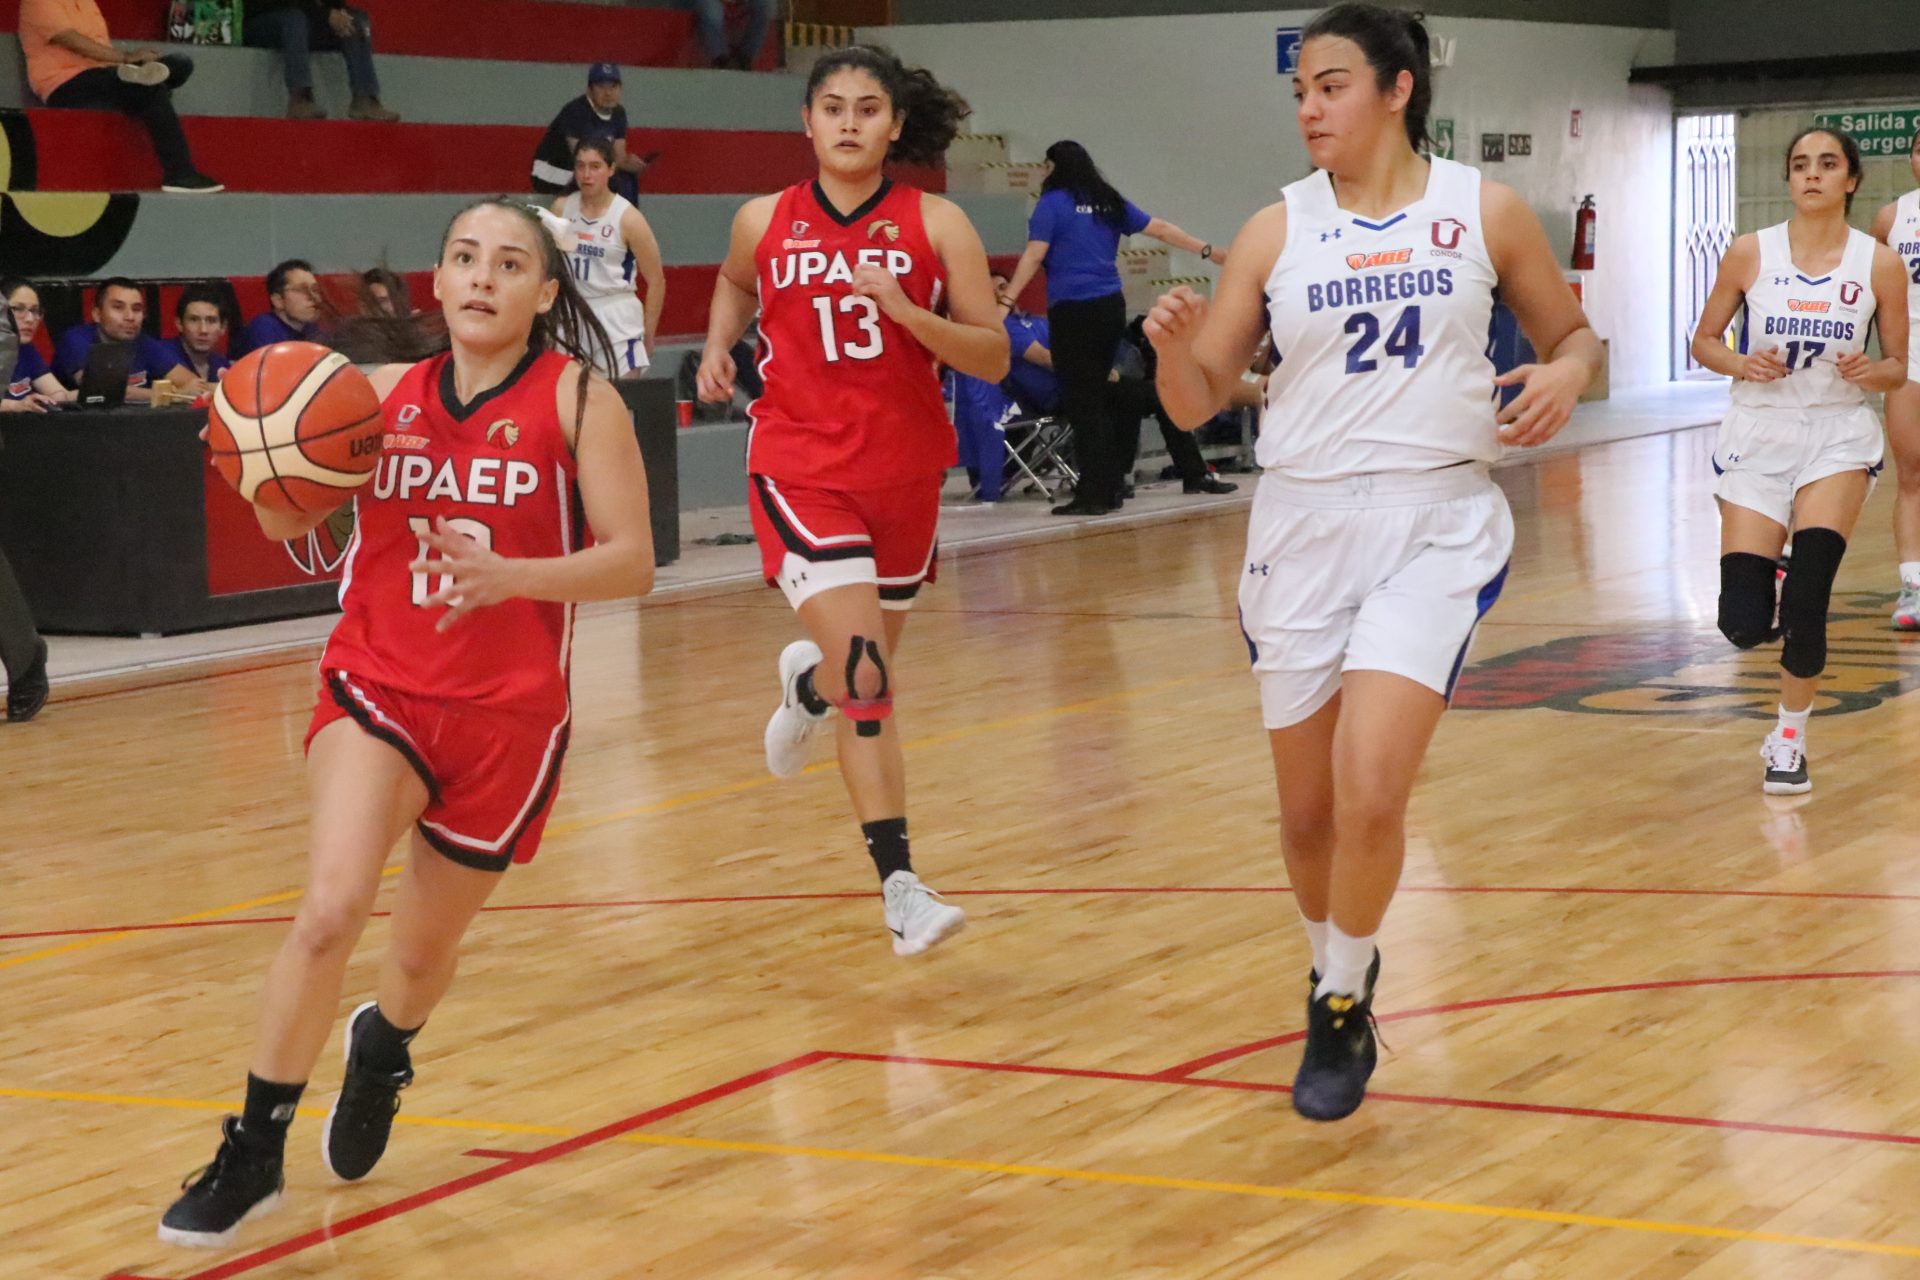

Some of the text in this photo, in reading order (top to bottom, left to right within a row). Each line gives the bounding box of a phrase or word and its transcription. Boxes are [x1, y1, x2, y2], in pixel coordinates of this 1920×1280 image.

[1840, 112, 1905, 132] Salida
[577, 243, 606, 258] REGOS
[1898, 241, 1920, 256] BOR
[573, 257, 590, 281] 11
[1307, 268, 1454, 313] BORREGOS
[812, 294, 884, 362] 13
[1344, 305, 1424, 375] 24
[1765, 316, 1855, 341] BORREGOS
[1785, 340, 1826, 374] 17
[373, 454, 540, 507] UPAEP
